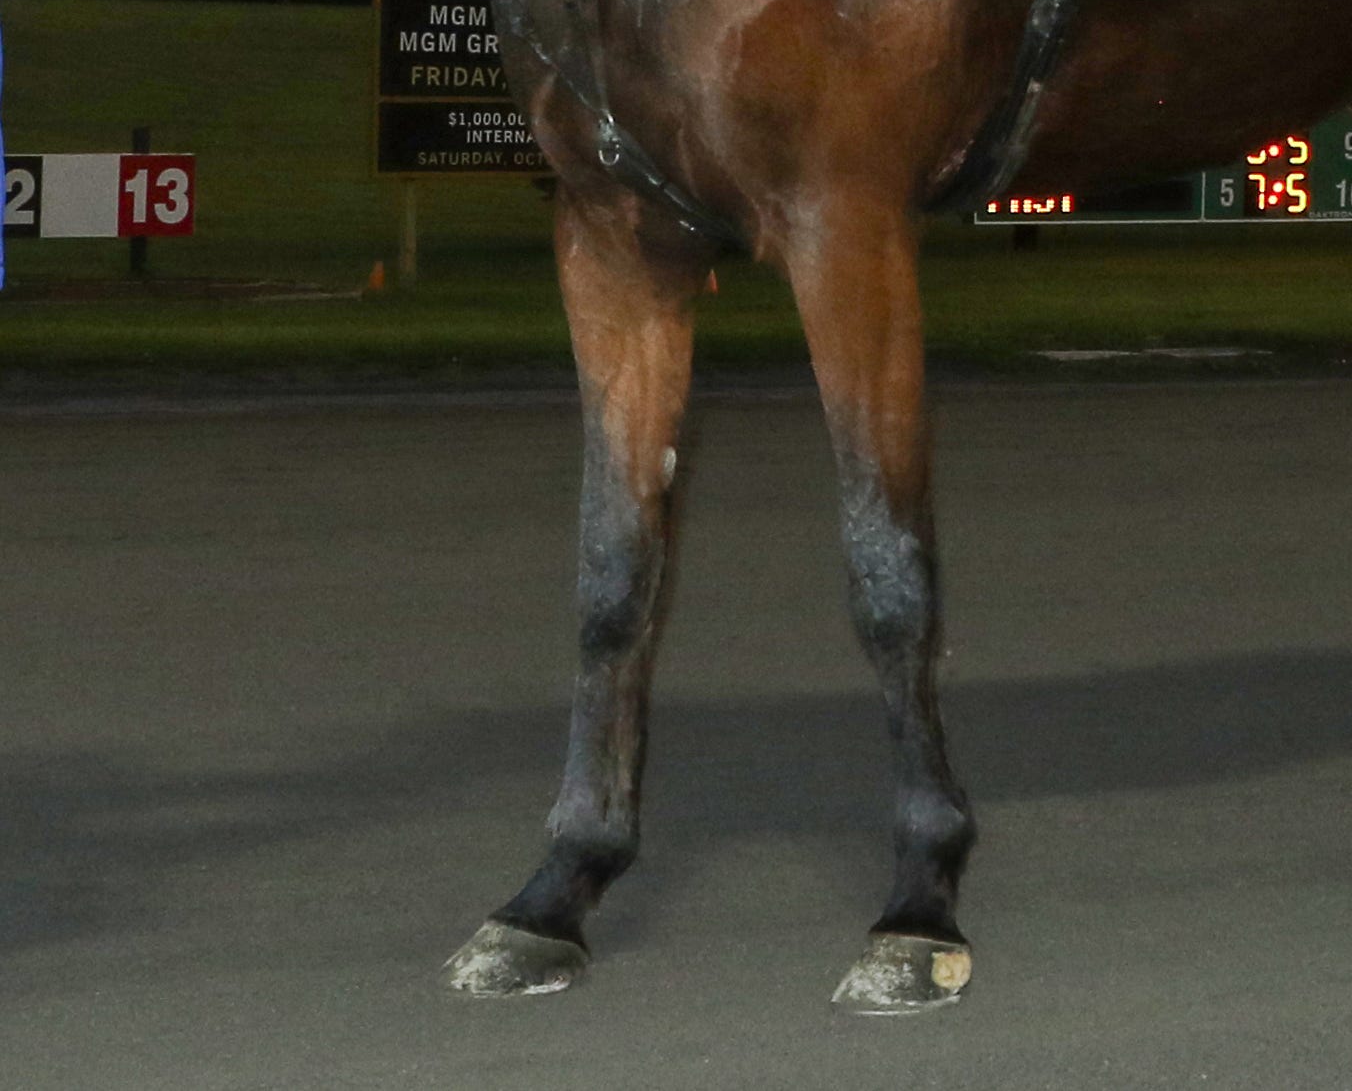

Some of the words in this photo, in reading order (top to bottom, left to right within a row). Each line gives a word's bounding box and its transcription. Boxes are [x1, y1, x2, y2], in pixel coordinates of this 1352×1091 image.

[429, 4, 487, 27] MGM
[399, 31, 457, 53] MGM
[411, 65, 508, 89] FRIDAY,
[124, 167, 190, 225] 13
[1220, 178, 1235, 207] 5
